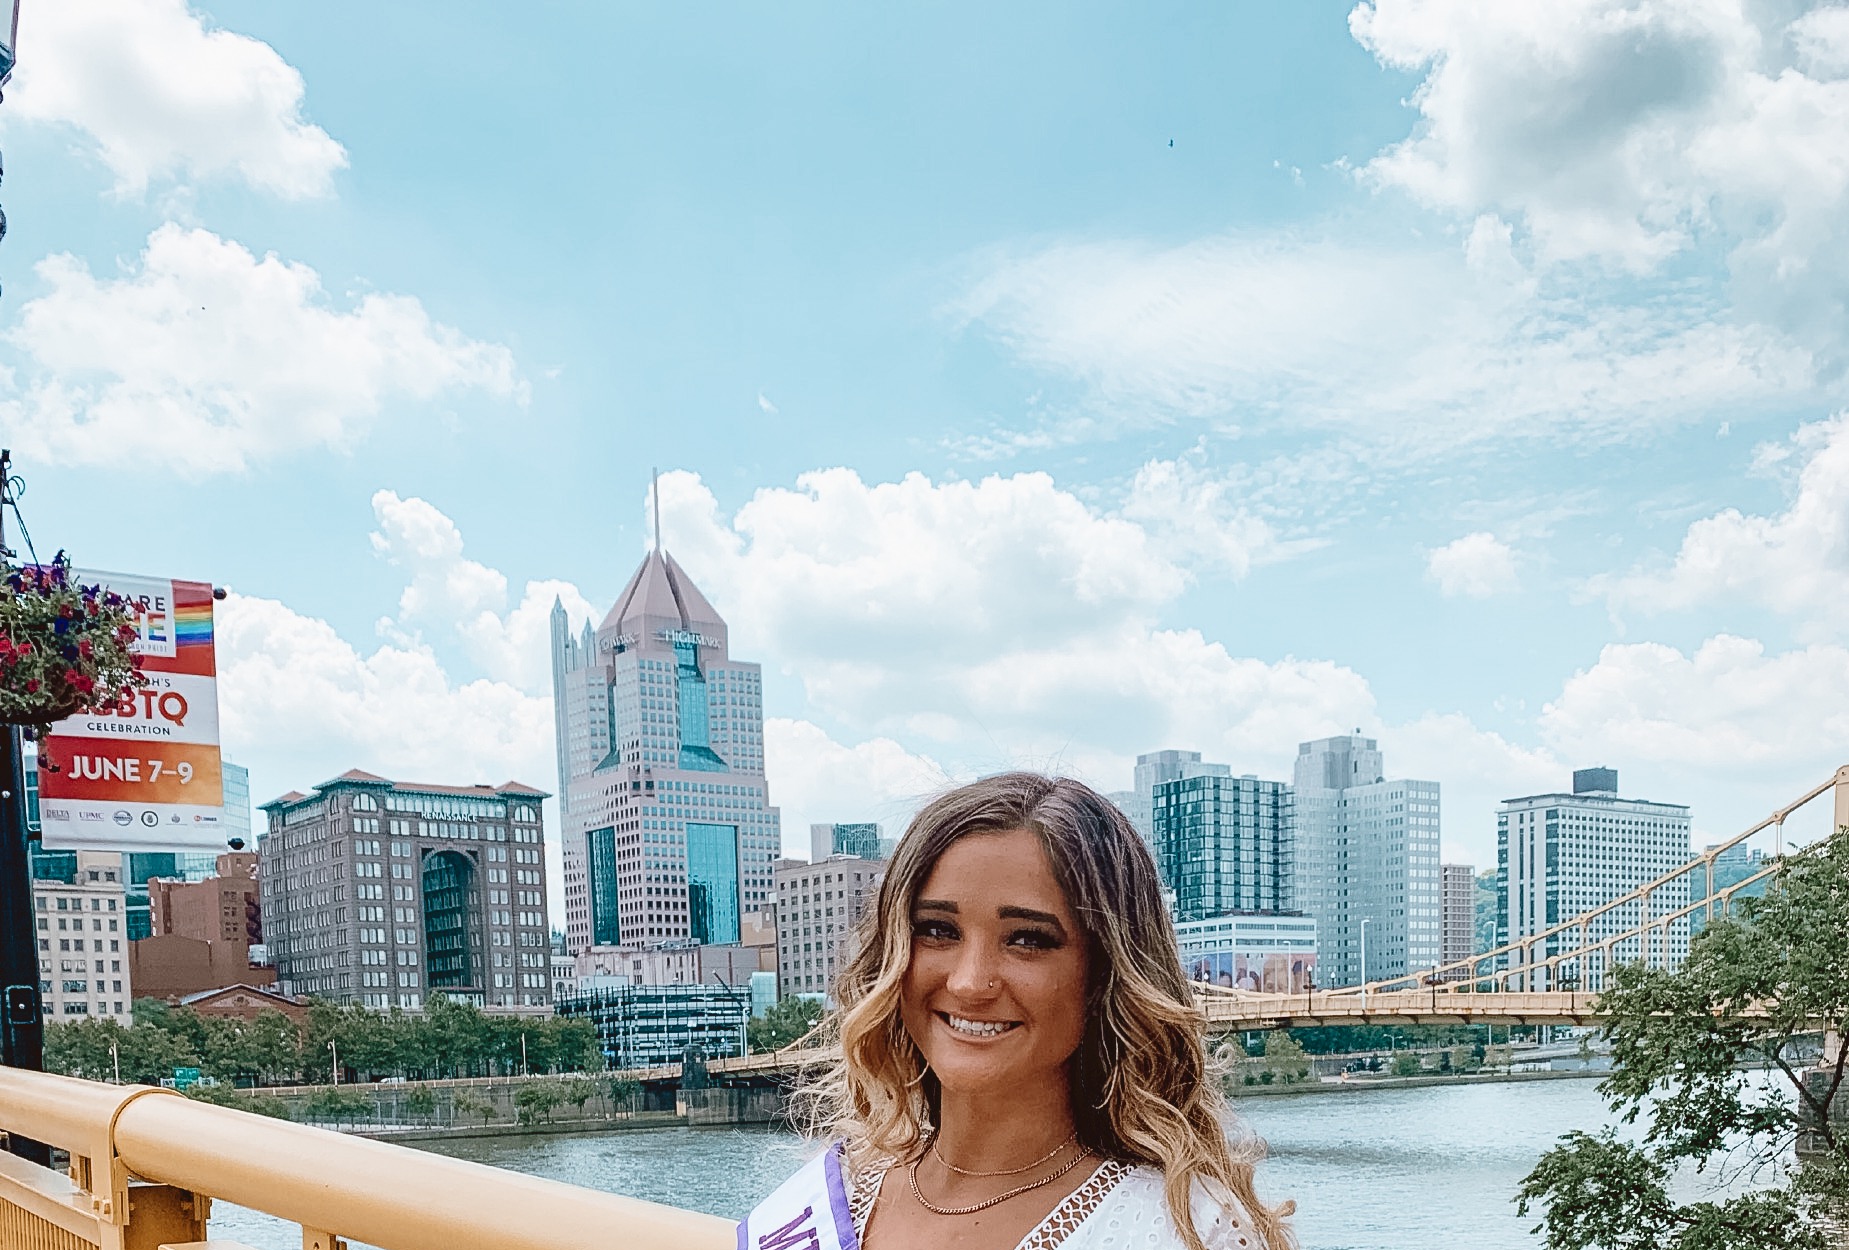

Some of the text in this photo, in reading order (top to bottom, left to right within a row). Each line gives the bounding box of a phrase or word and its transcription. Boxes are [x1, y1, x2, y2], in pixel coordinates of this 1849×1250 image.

[75, 686, 188, 727] BTQ
[87, 722, 171, 736] CELEBRATION
[68, 755, 141, 782] JUNE
[46, 809, 69, 818] DELTA
[79, 811, 104, 819] UPMC
[421, 811, 478, 822] RENAISSANCE
